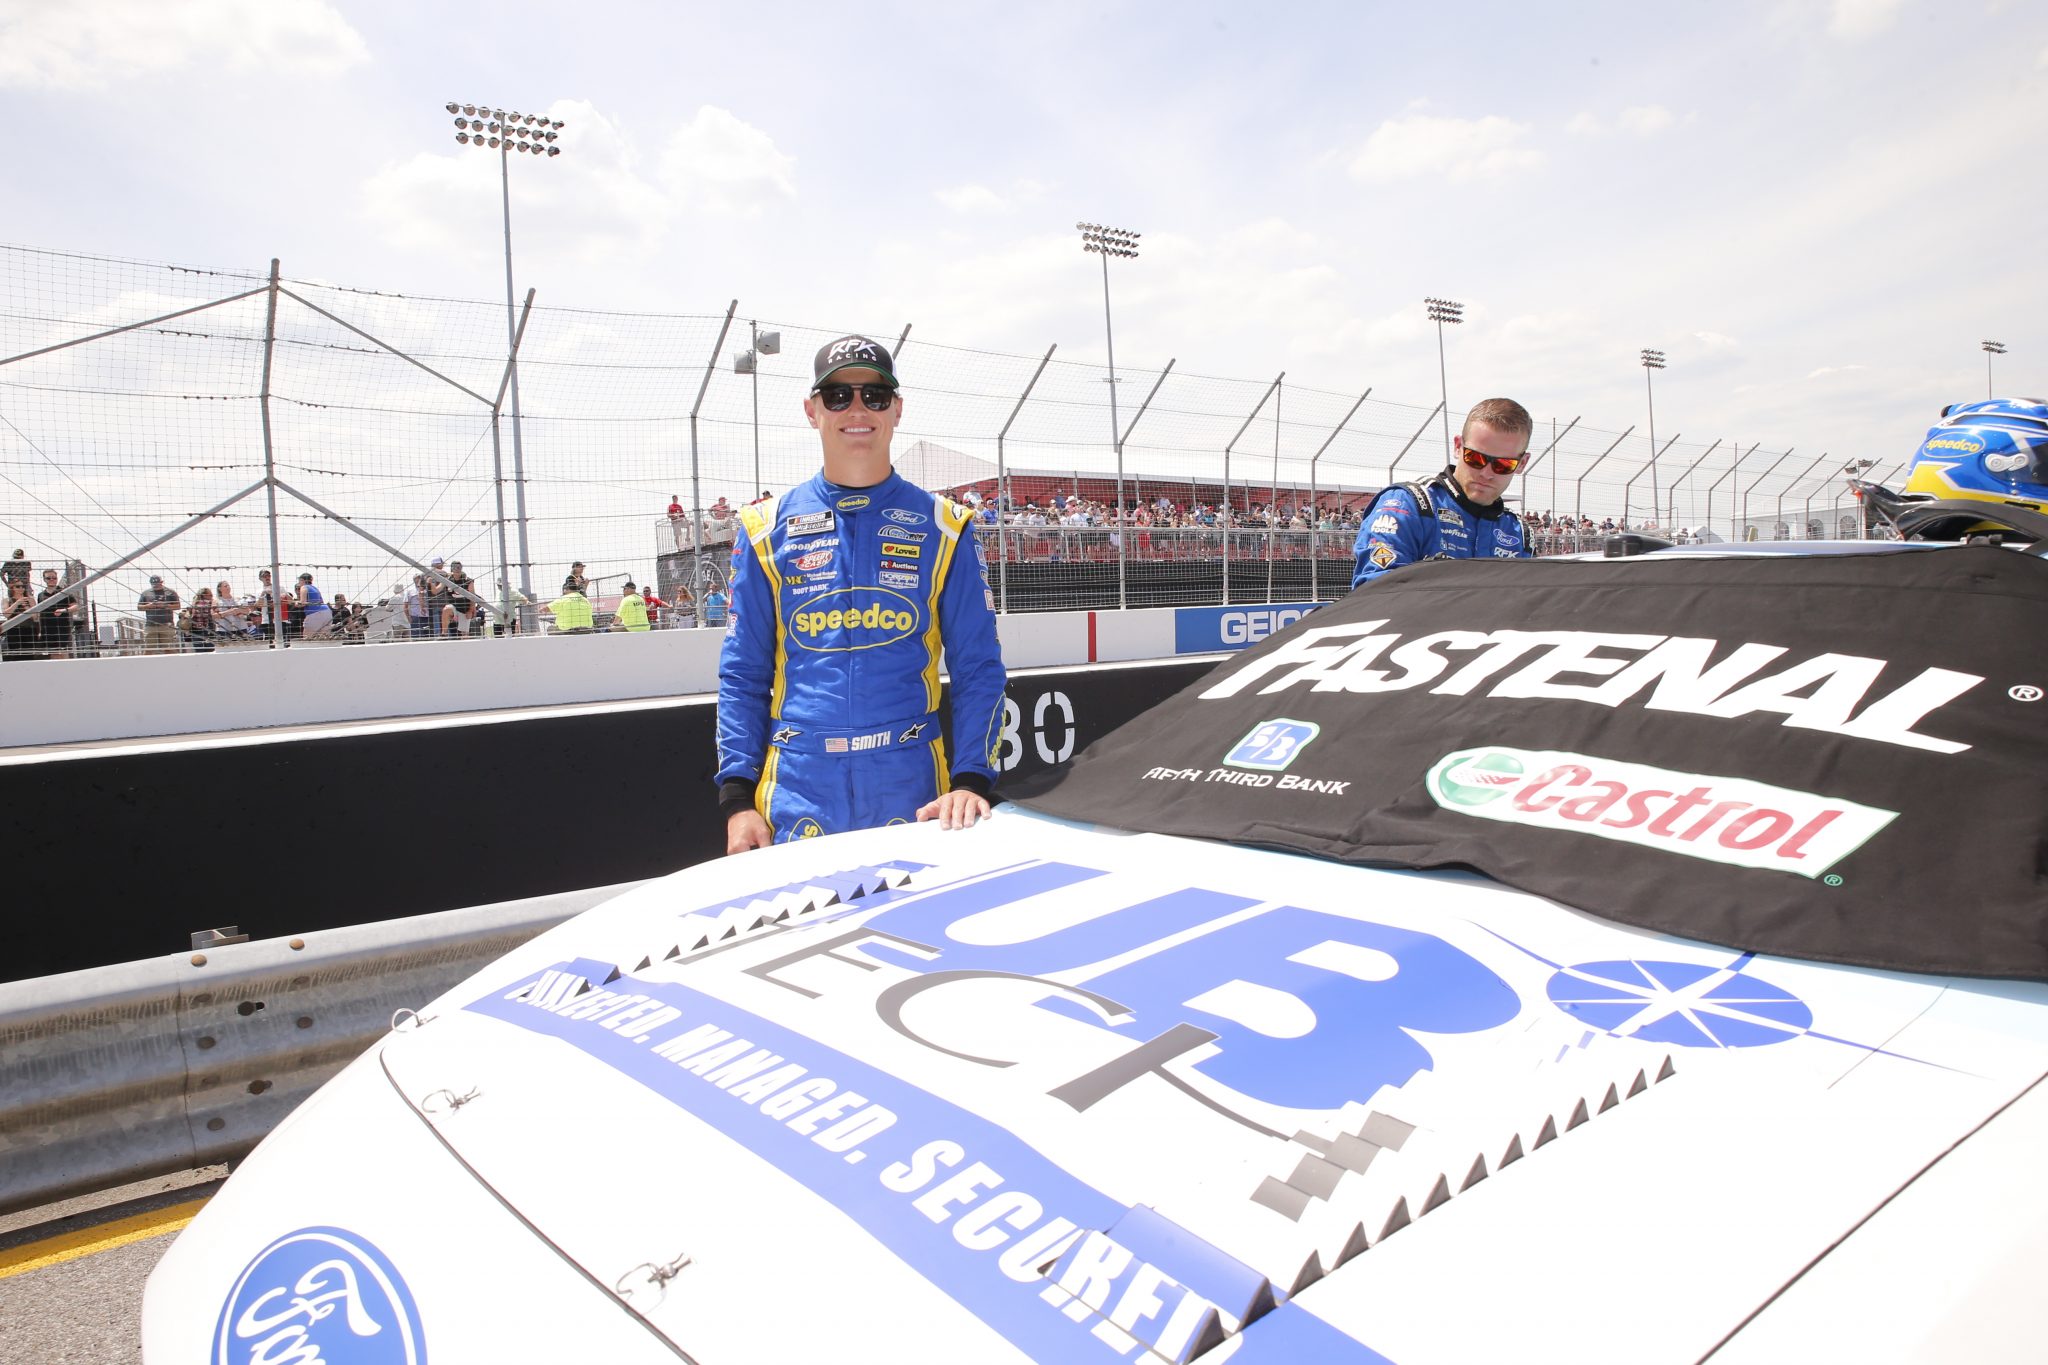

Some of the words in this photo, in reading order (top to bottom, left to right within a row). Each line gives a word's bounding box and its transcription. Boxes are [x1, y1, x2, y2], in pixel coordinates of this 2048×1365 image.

[827, 339, 878, 359] RFK
[828, 352, 877, 365] RACING
[1926, 438, 1981, 453] speedco
[838, 498, 868, 508] speedco
[890, 509, 919, 524] Ford
[784, 537, 840, 552] GOODYEAR
[795, 603, 913, 637] speedco
[1220, 609, 1314, 644] GEIC
[1197, 618, 1986, 755] FASTENAL
[851, 730, 892, 751] SMITH
[1204, 768, 1274, 788] THIRD
[1276, 774, 1352, 795] BANK
[1512, 764, 1844, 860] Castrol
[650, 1021, 899, 1164] MANAGED.
[235, 1258, 383, 1365] Fo
